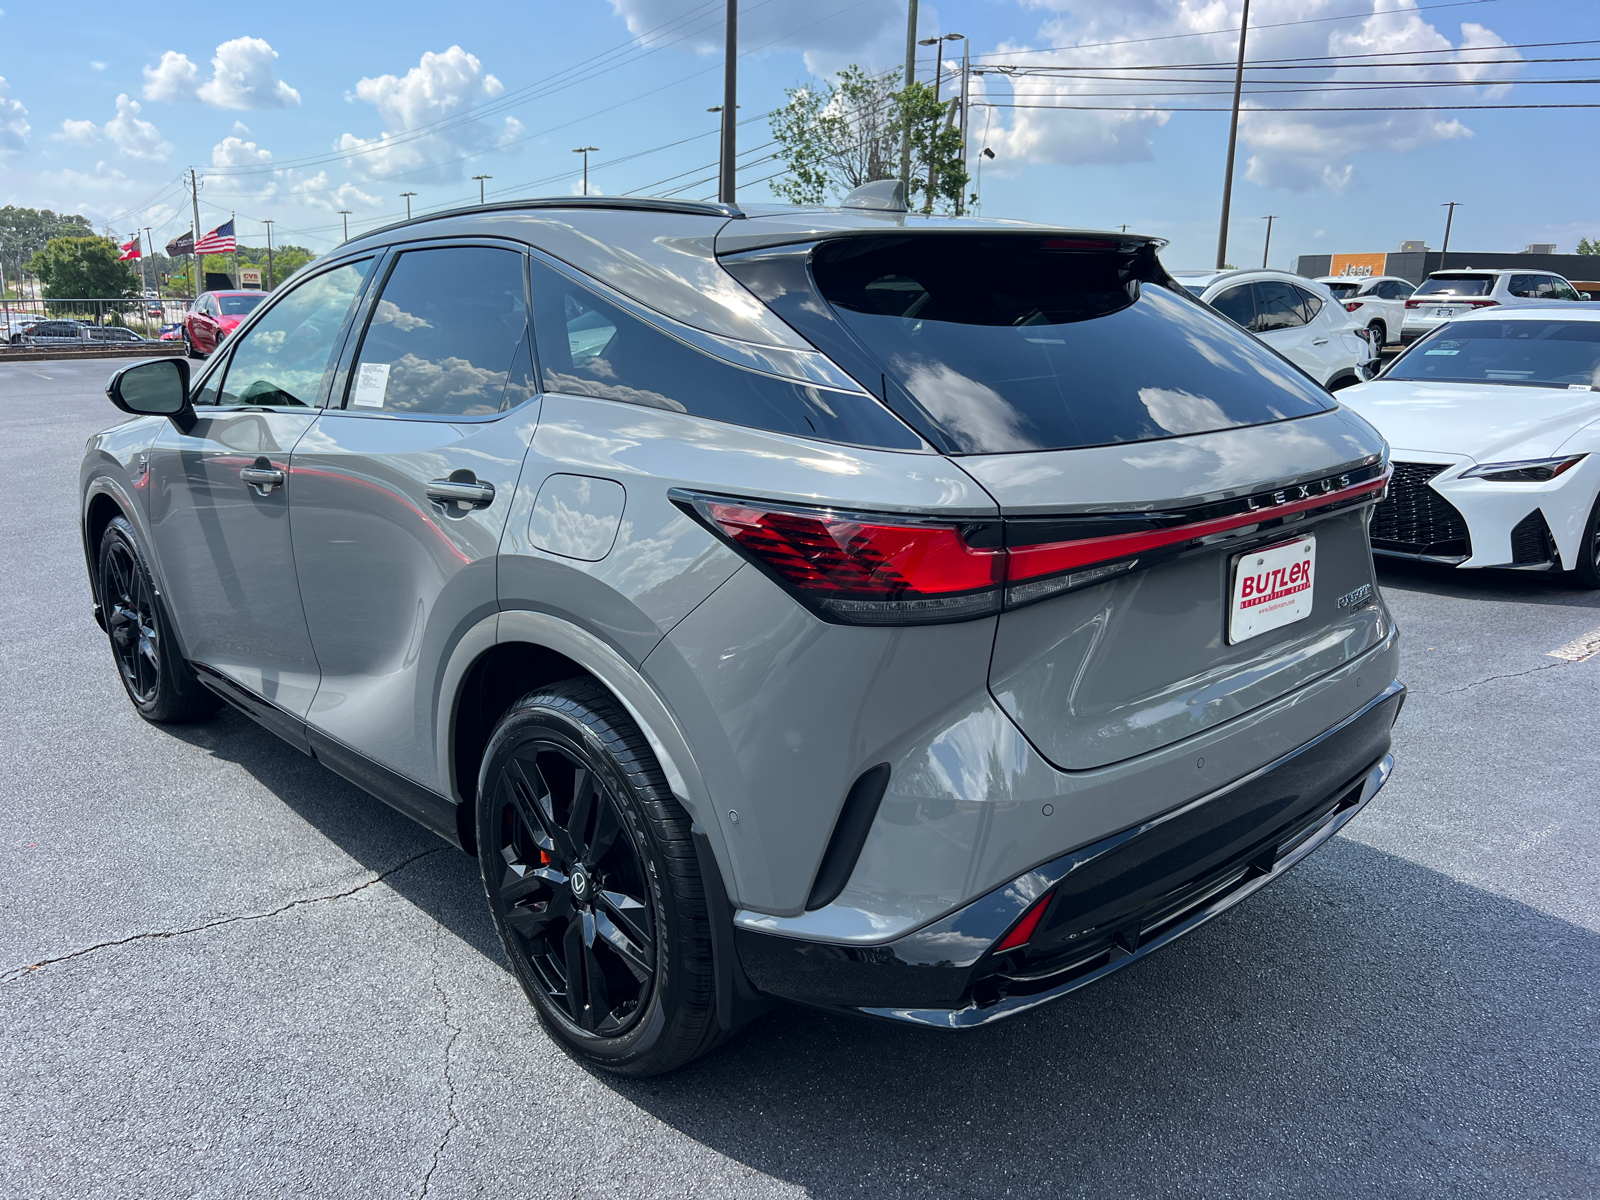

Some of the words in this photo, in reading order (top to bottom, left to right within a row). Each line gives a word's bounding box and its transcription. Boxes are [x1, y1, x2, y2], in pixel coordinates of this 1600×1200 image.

[1341, 263, 1372, 276] Jeep
[1247, 474, 1350, 510] LEXUS
[1240, 590, 1285, 609] AUTOMOTIVE
[1291, 581, 1311, 594] GROUP
[598, 762, 648, 846] EAGLE
[649, 860, 668, 987] TOURING
